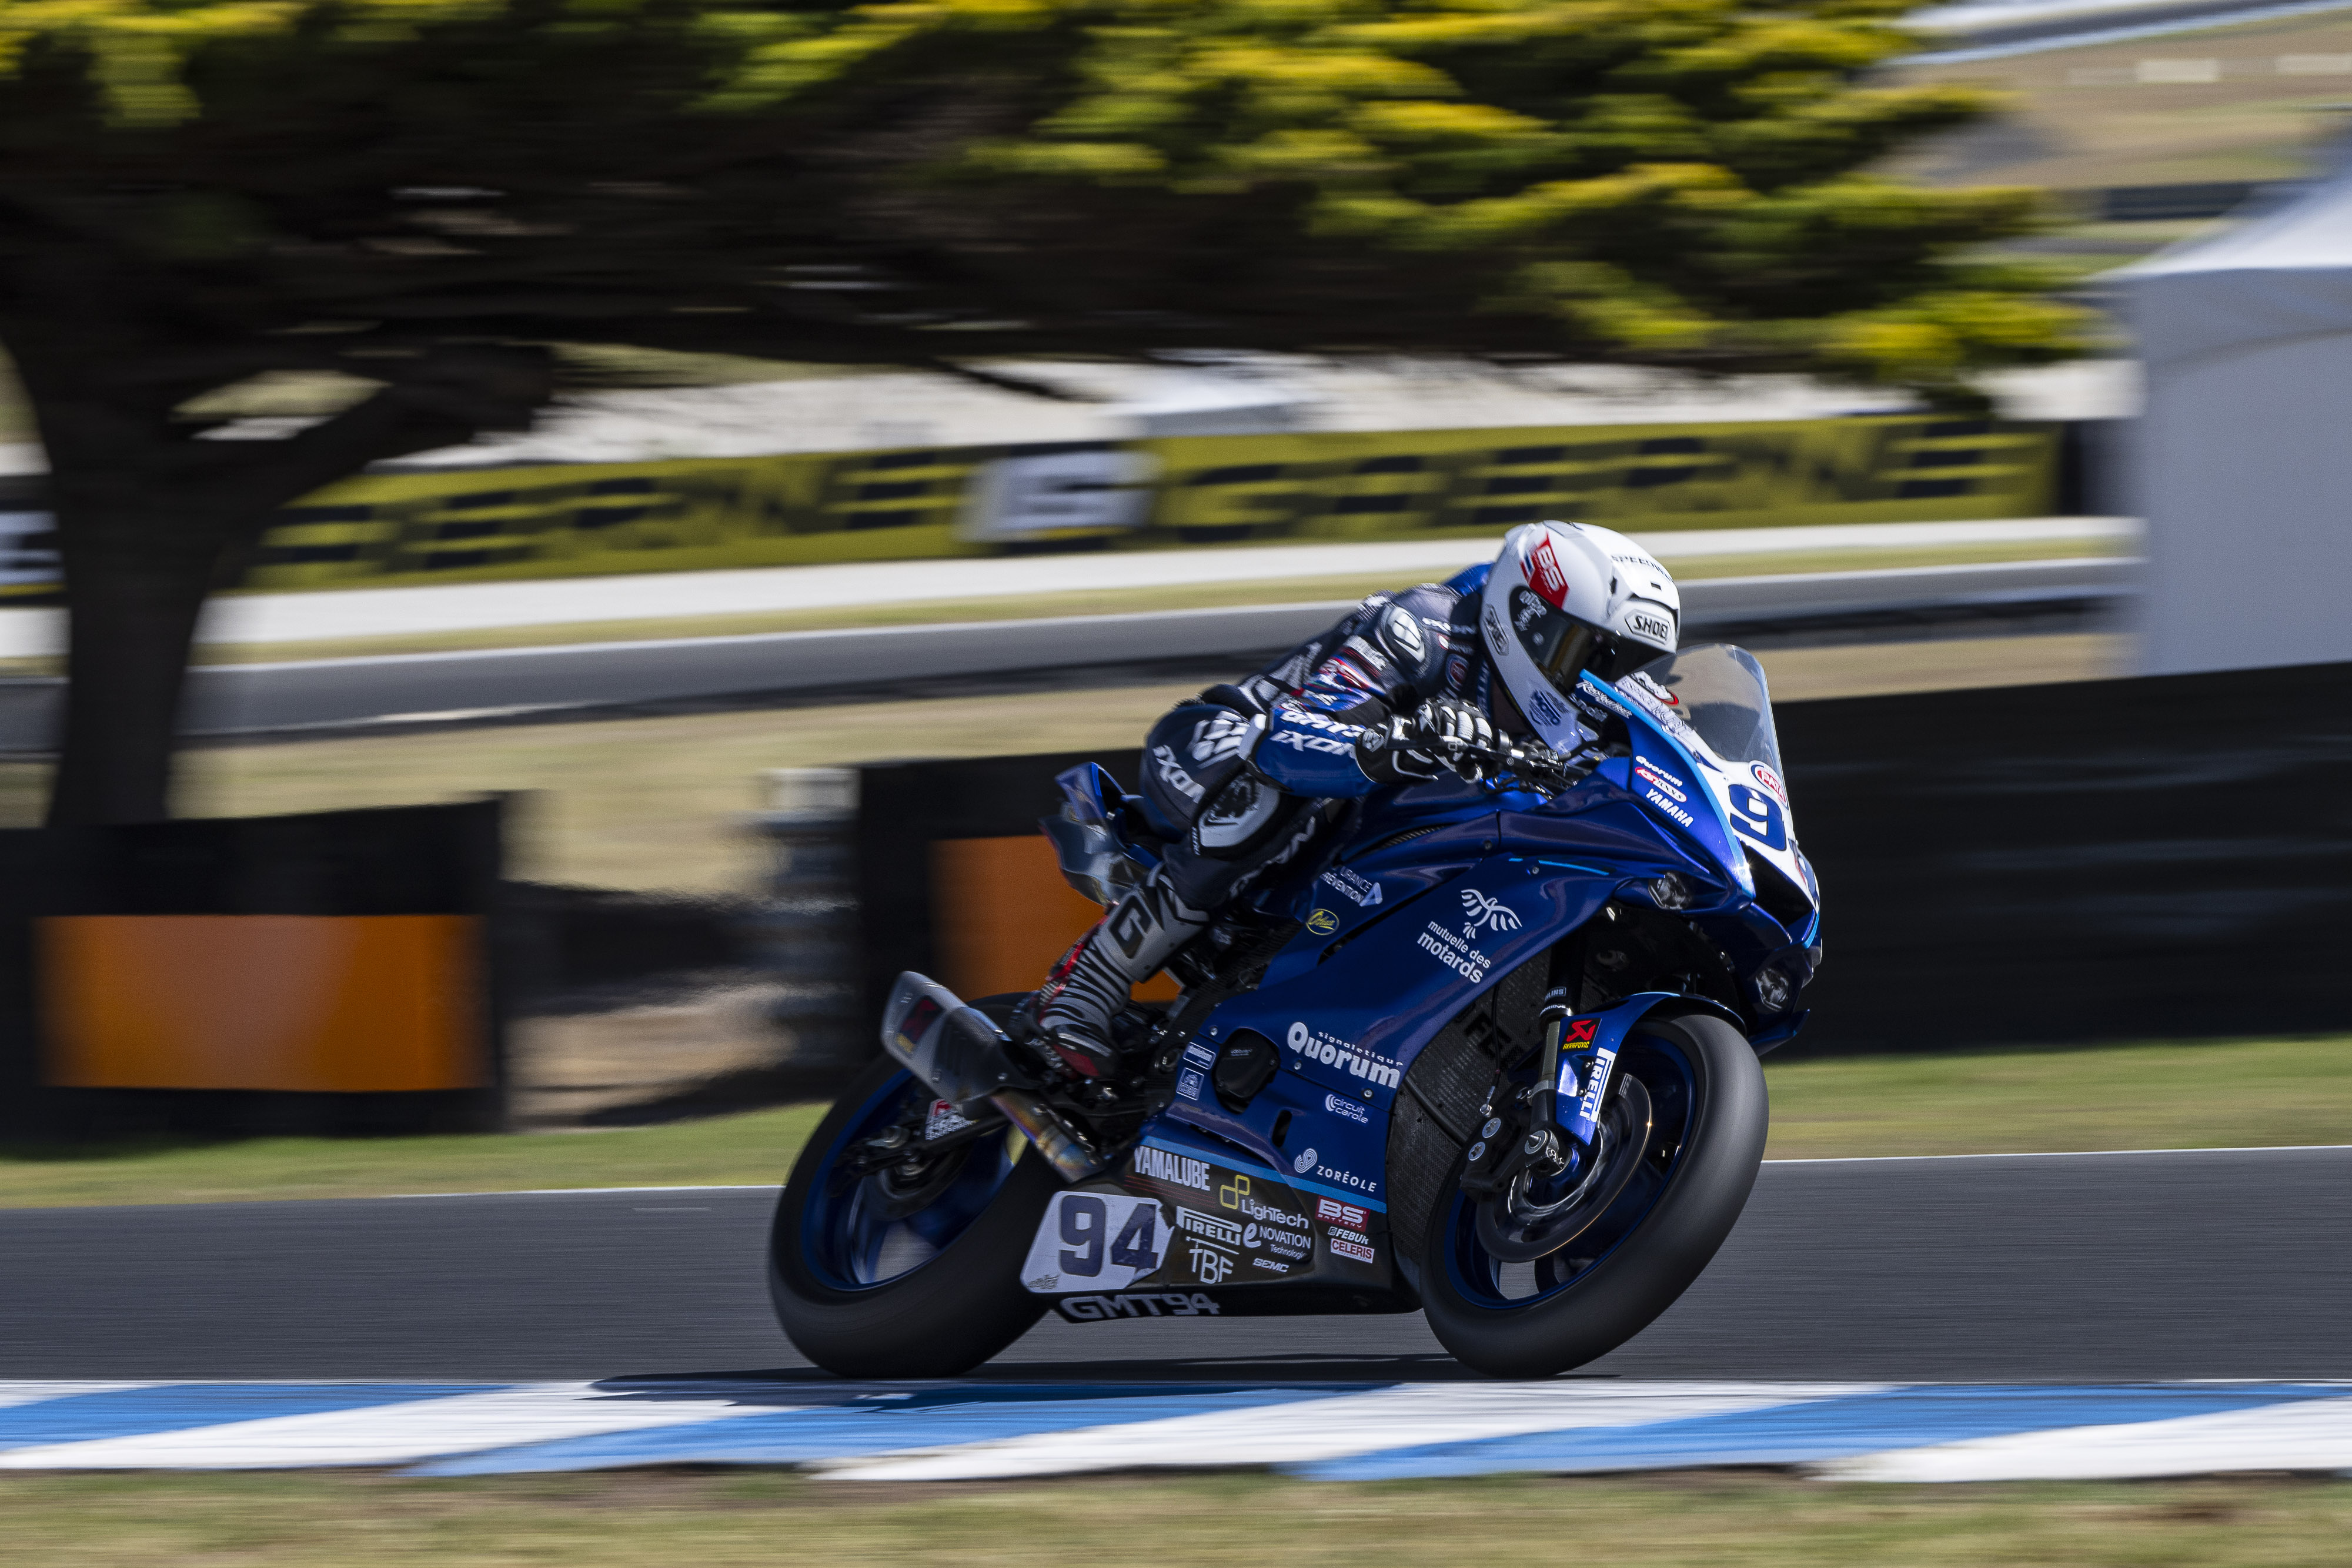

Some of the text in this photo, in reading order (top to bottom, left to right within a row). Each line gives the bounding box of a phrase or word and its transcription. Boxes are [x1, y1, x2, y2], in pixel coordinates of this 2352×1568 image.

[1536, 545, 1565, 592] BS
[1758, 768, 1786, 804] PATA
[1646, 788, 1694, 828] YAMAHA
[1416, 931, 1483, 984] motards
[1428, 920, 1491, 969] mutuelle des
[1287, 1021, 1401, 1089] Quorum
[1579, 1047, 1617, 1123] PIRELLI
[1334, 1096, 1365, 1115] circuit
[1335, 1106, 1369, 1124] carole
[1134, 1145, 1211, 1192] YAMALUBE
[1317, 1165, 1377, 1192] ZORÉOLE
[1175, 1206, 1242, 1246] PIRELLI
[1241, 1198, 1309, 1229] LighTech
[1317, 1213, 1364, 1229] BATTERY
[1318, 1198, 1364, 1224] BS
[1058, 1194, 1160, 1278] 94
[1332, 1240, 1372, 1259] CELERIS
[1189, 1249, 1234, 1285] TBF
[1252, 1257, 1289, 1273] SEMC
[1058, 1292, 1221, 1319] GMT94
